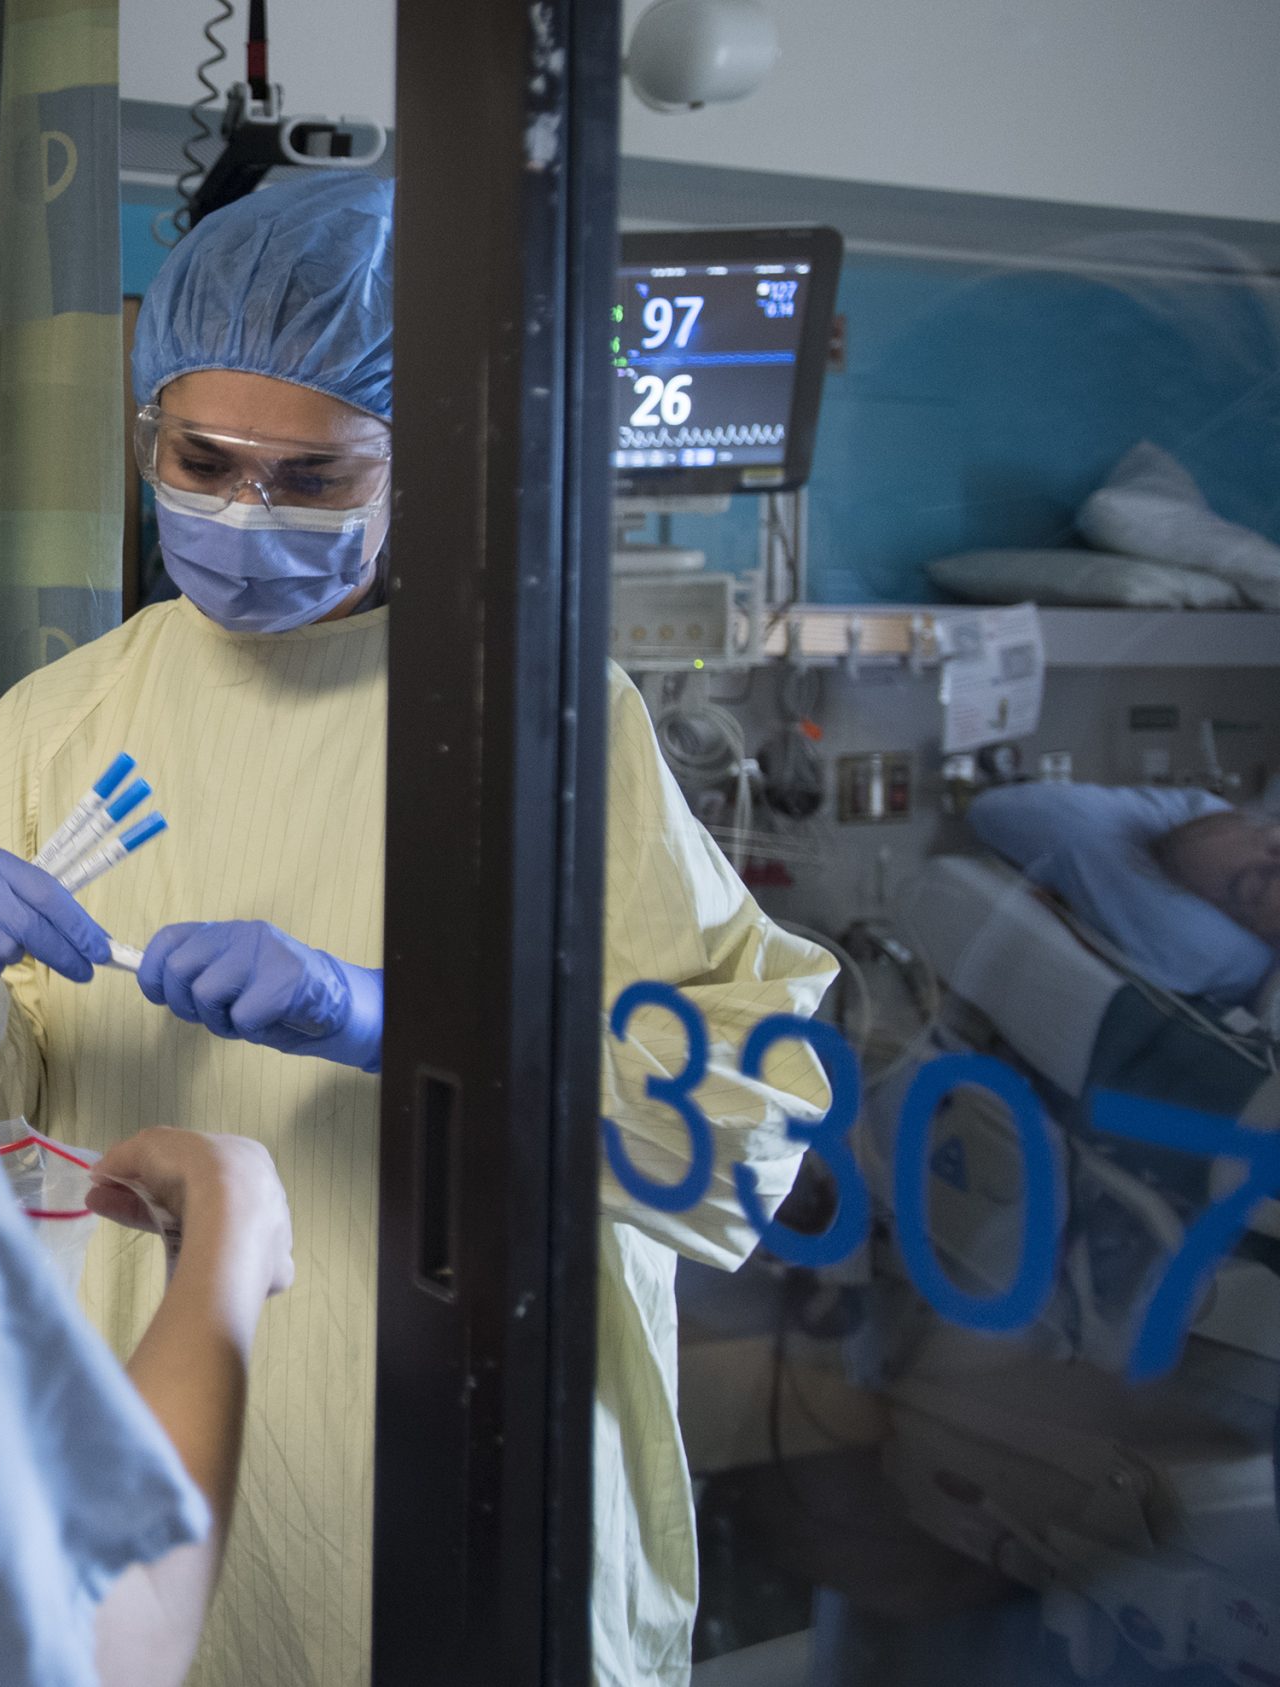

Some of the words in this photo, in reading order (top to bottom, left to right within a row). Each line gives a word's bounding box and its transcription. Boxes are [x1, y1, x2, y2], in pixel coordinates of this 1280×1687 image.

[641, 296, 704, 350] 97
[629, 373, 693, 427] 26
[599, 980, 1280, 1386] 3307
